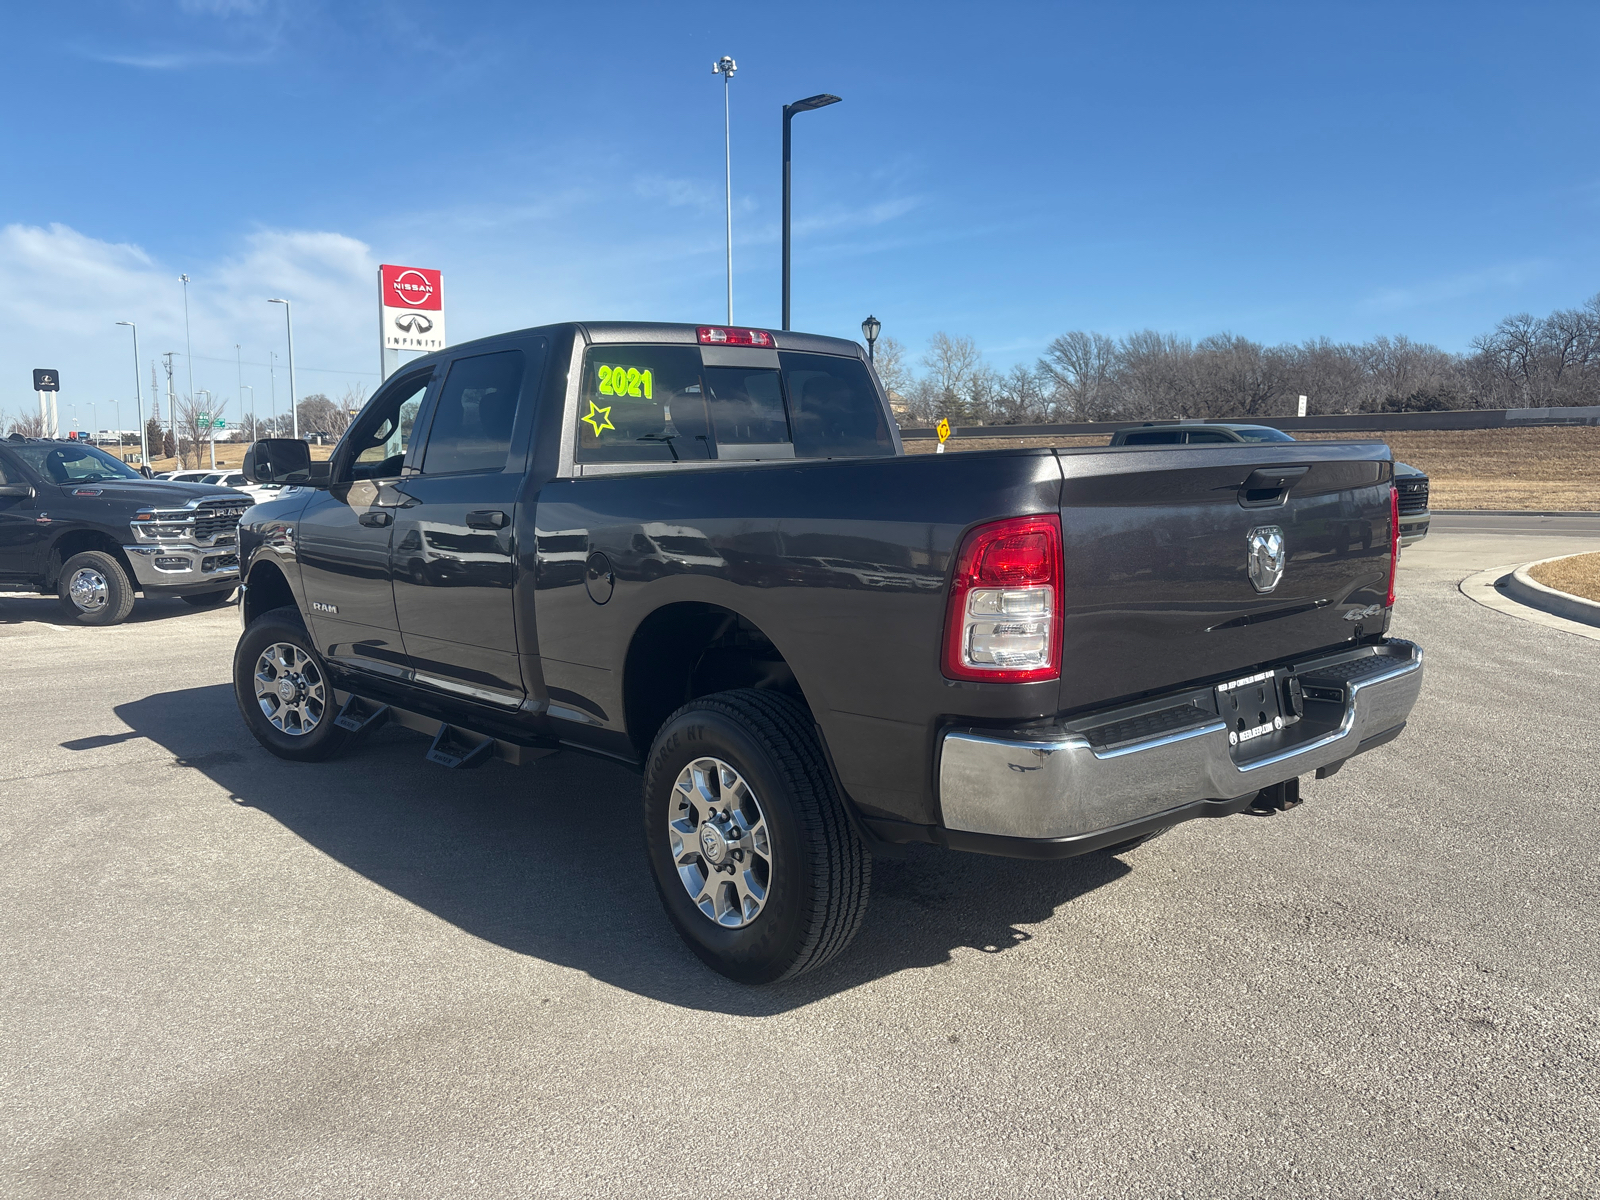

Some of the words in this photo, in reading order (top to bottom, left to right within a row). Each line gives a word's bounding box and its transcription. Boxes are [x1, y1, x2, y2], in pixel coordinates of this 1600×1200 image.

[393, 282, 433, 293] NISSAN
[387, 336, 442, 348] INFINITI
[598, 365, 653, 400] 2021
[313, 601, 339, 614] RAM
[686, 724, 705, 742] HT
